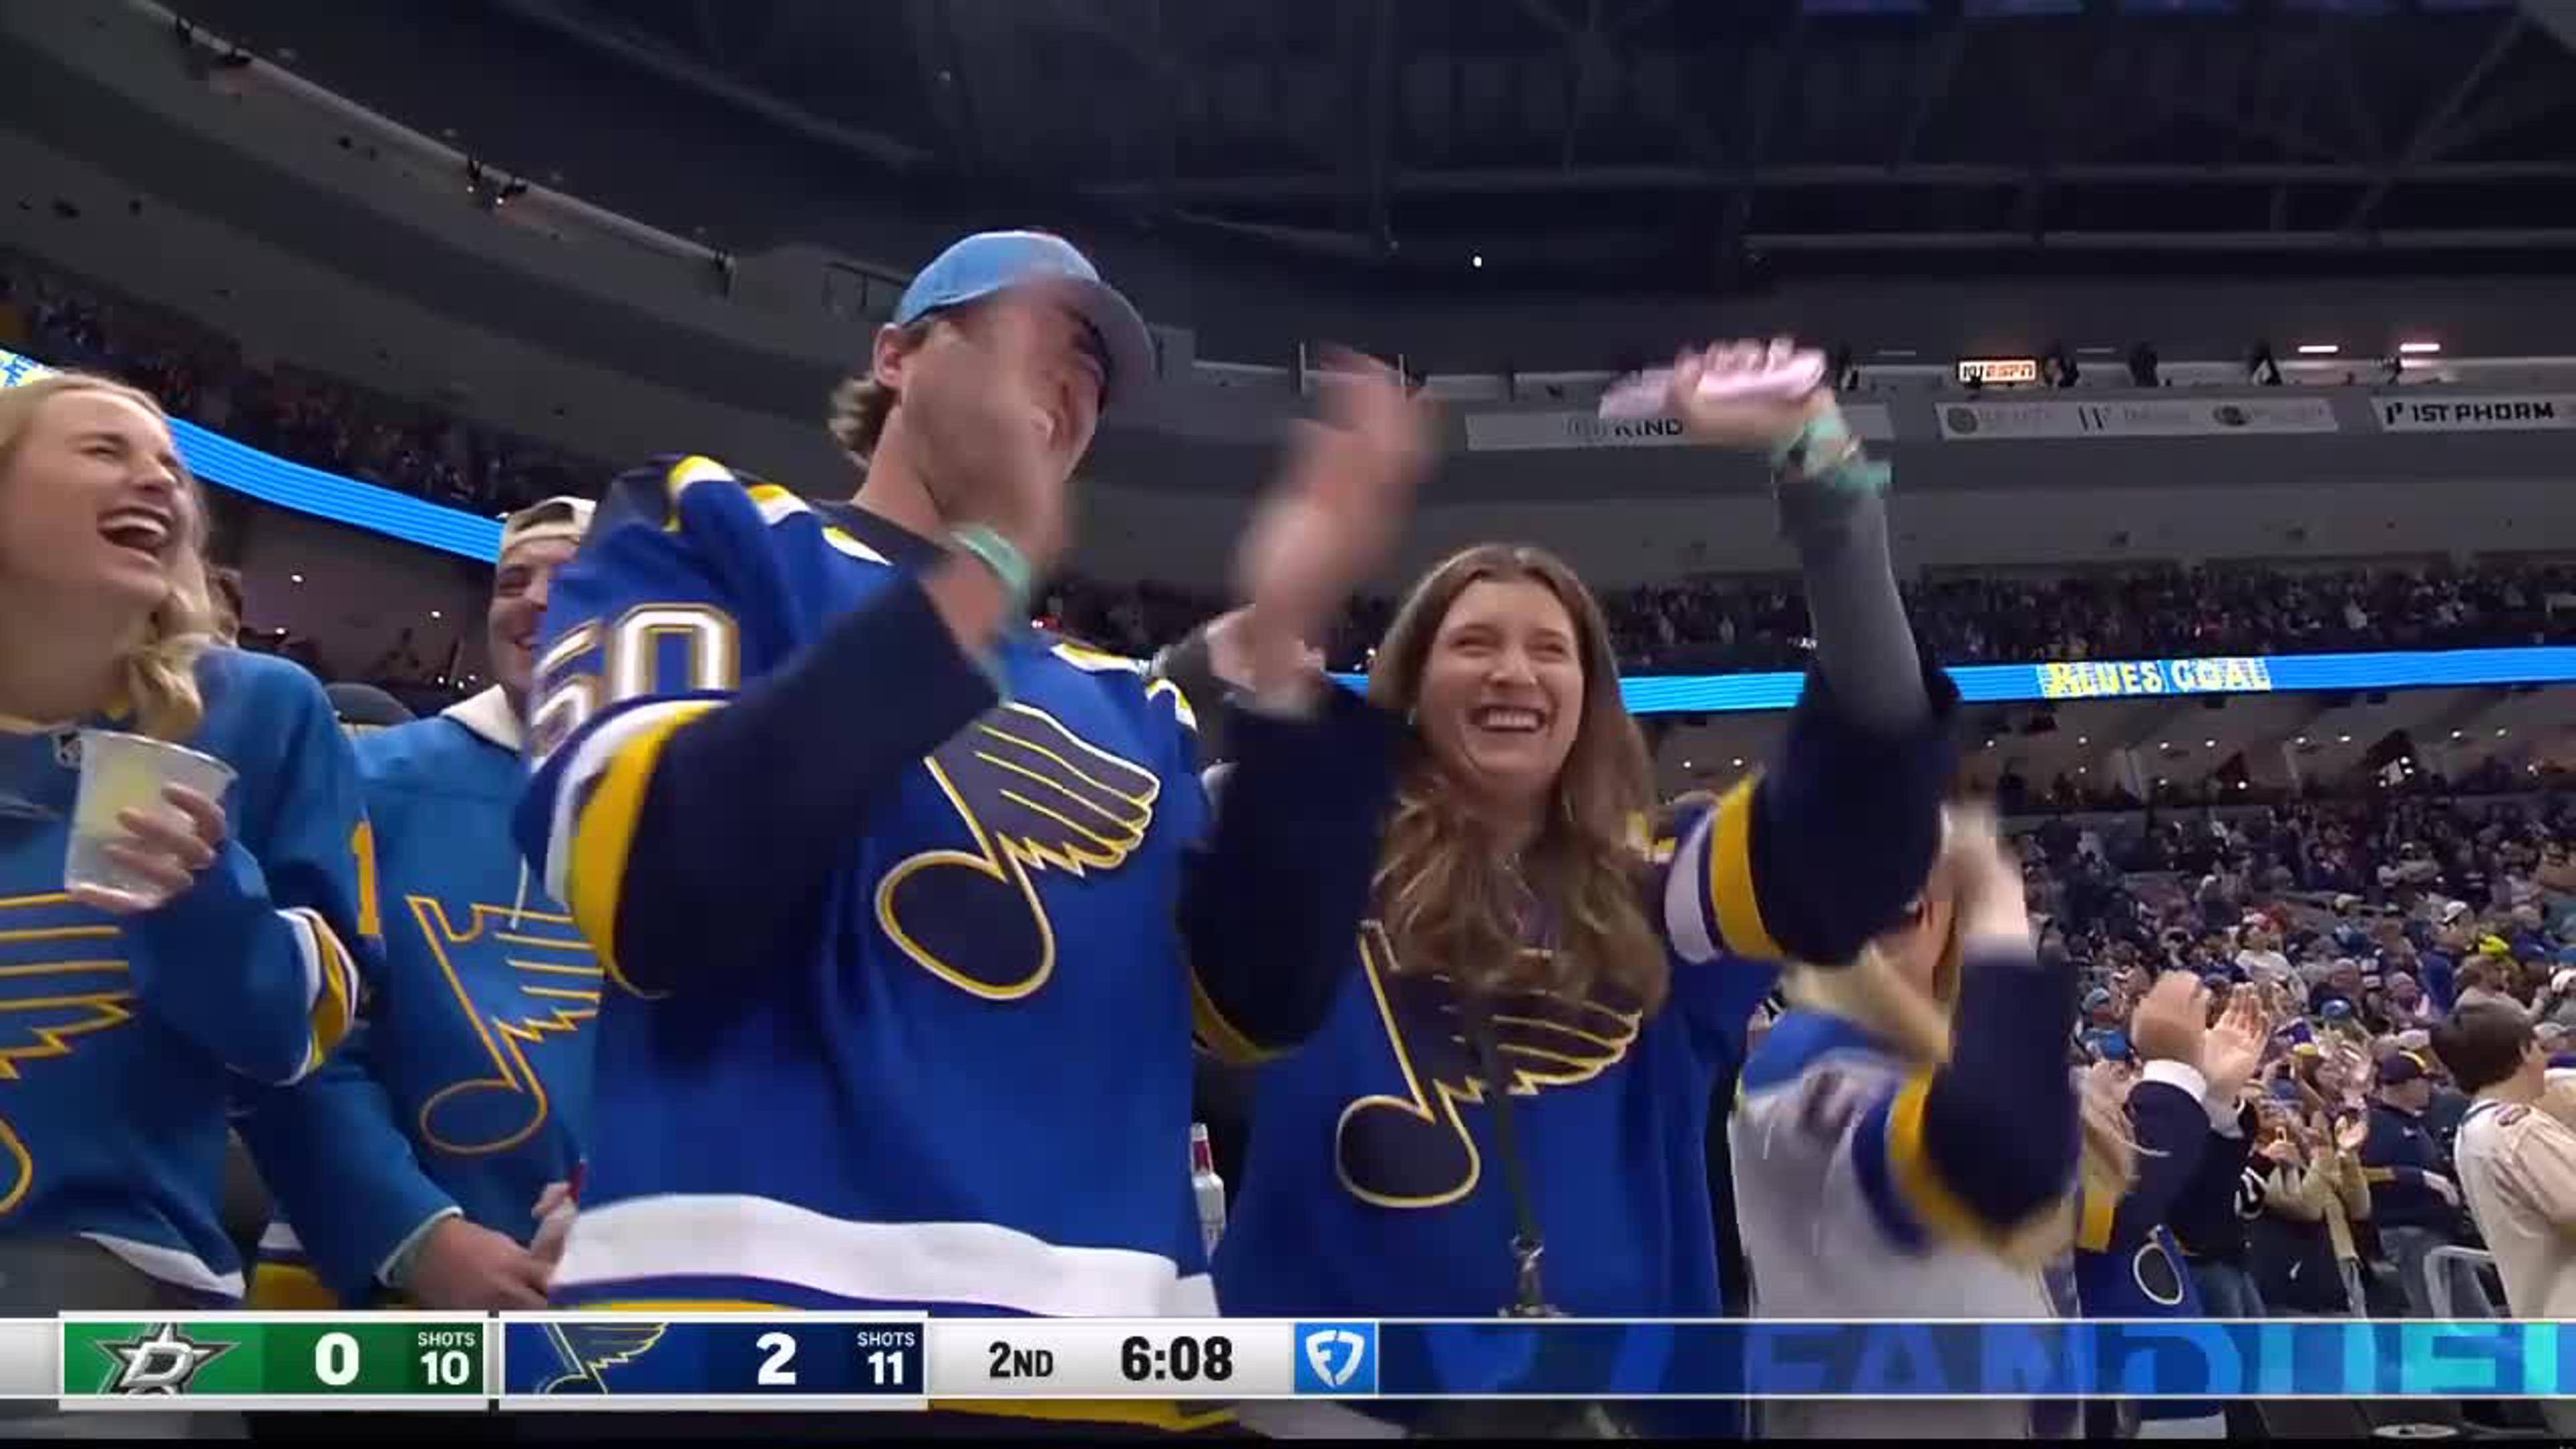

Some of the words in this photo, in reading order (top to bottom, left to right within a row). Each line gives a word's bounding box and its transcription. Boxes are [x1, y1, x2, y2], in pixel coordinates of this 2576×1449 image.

[2412, 404, 2450, 422] 1ST
[2455, 402, 2554, 422] PHORM
[2171, 656, 2271, 694] GOAL
